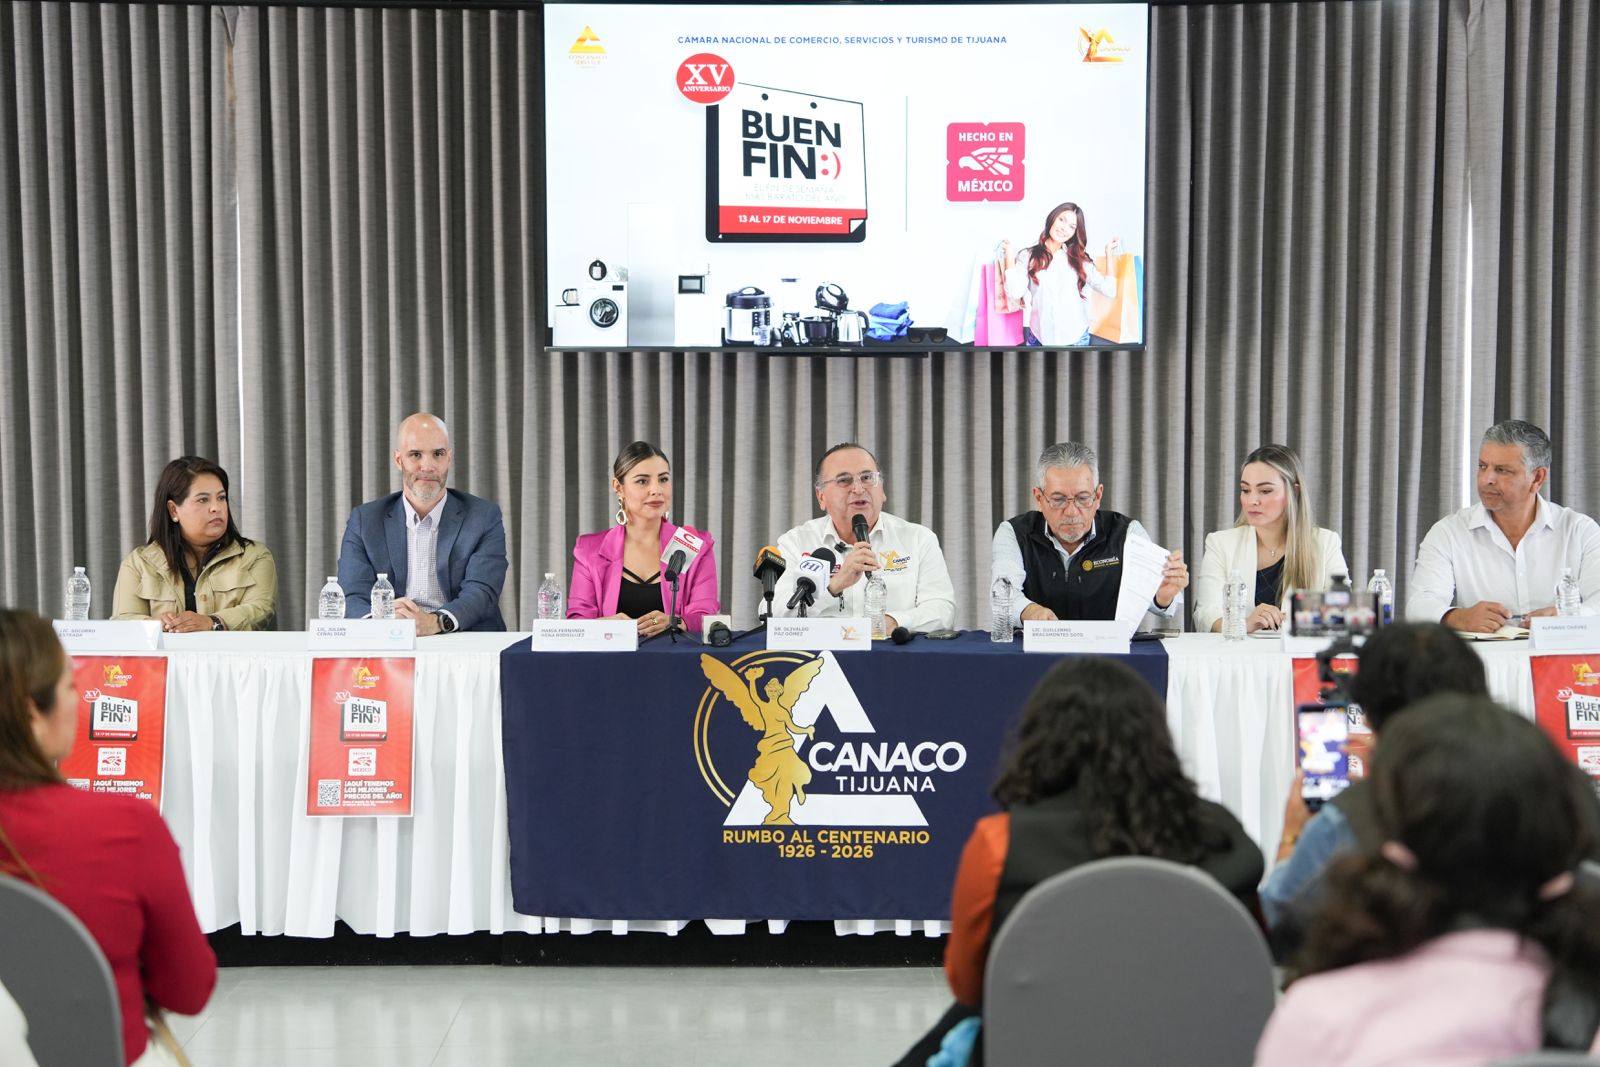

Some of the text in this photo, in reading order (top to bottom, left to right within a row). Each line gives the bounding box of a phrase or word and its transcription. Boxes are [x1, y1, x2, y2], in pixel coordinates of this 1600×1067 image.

[722, 36, 771, 45] NACIONAL
[774, 36, 787, 45] DE
[789, 36, 842, 46] COMERCIO,
[844, 36, 894, 45] SERVICIOS
[897, 36, 904, 45] Y
[906, 36, 948, 45] TURISMO
[951, 36, 963, 45] DE
[966, 36, 1007, 45] TIJUANA
[684, 64, 729, 85] XV
[742, 109, 841, 148] BUEN
[958, 132, 1014, 142] HECHO EN
[957, 178, 1013, 192] MÉXICO
[738, 215, 843, 225] 13 AL 17 DE NOVIEMBRE
[101, 702, 131, 713] BUEN
[351, 703, 381, 714] BUEN
[808, 741, 967, 773] CANACO
[835, 776, 936, 792] TIJUANA
[722, 829, 930, 845] RUMBO AL CENTENARIO
[778, 843, 815, 858] 1926
[831, 844, 874, 859] 2026
